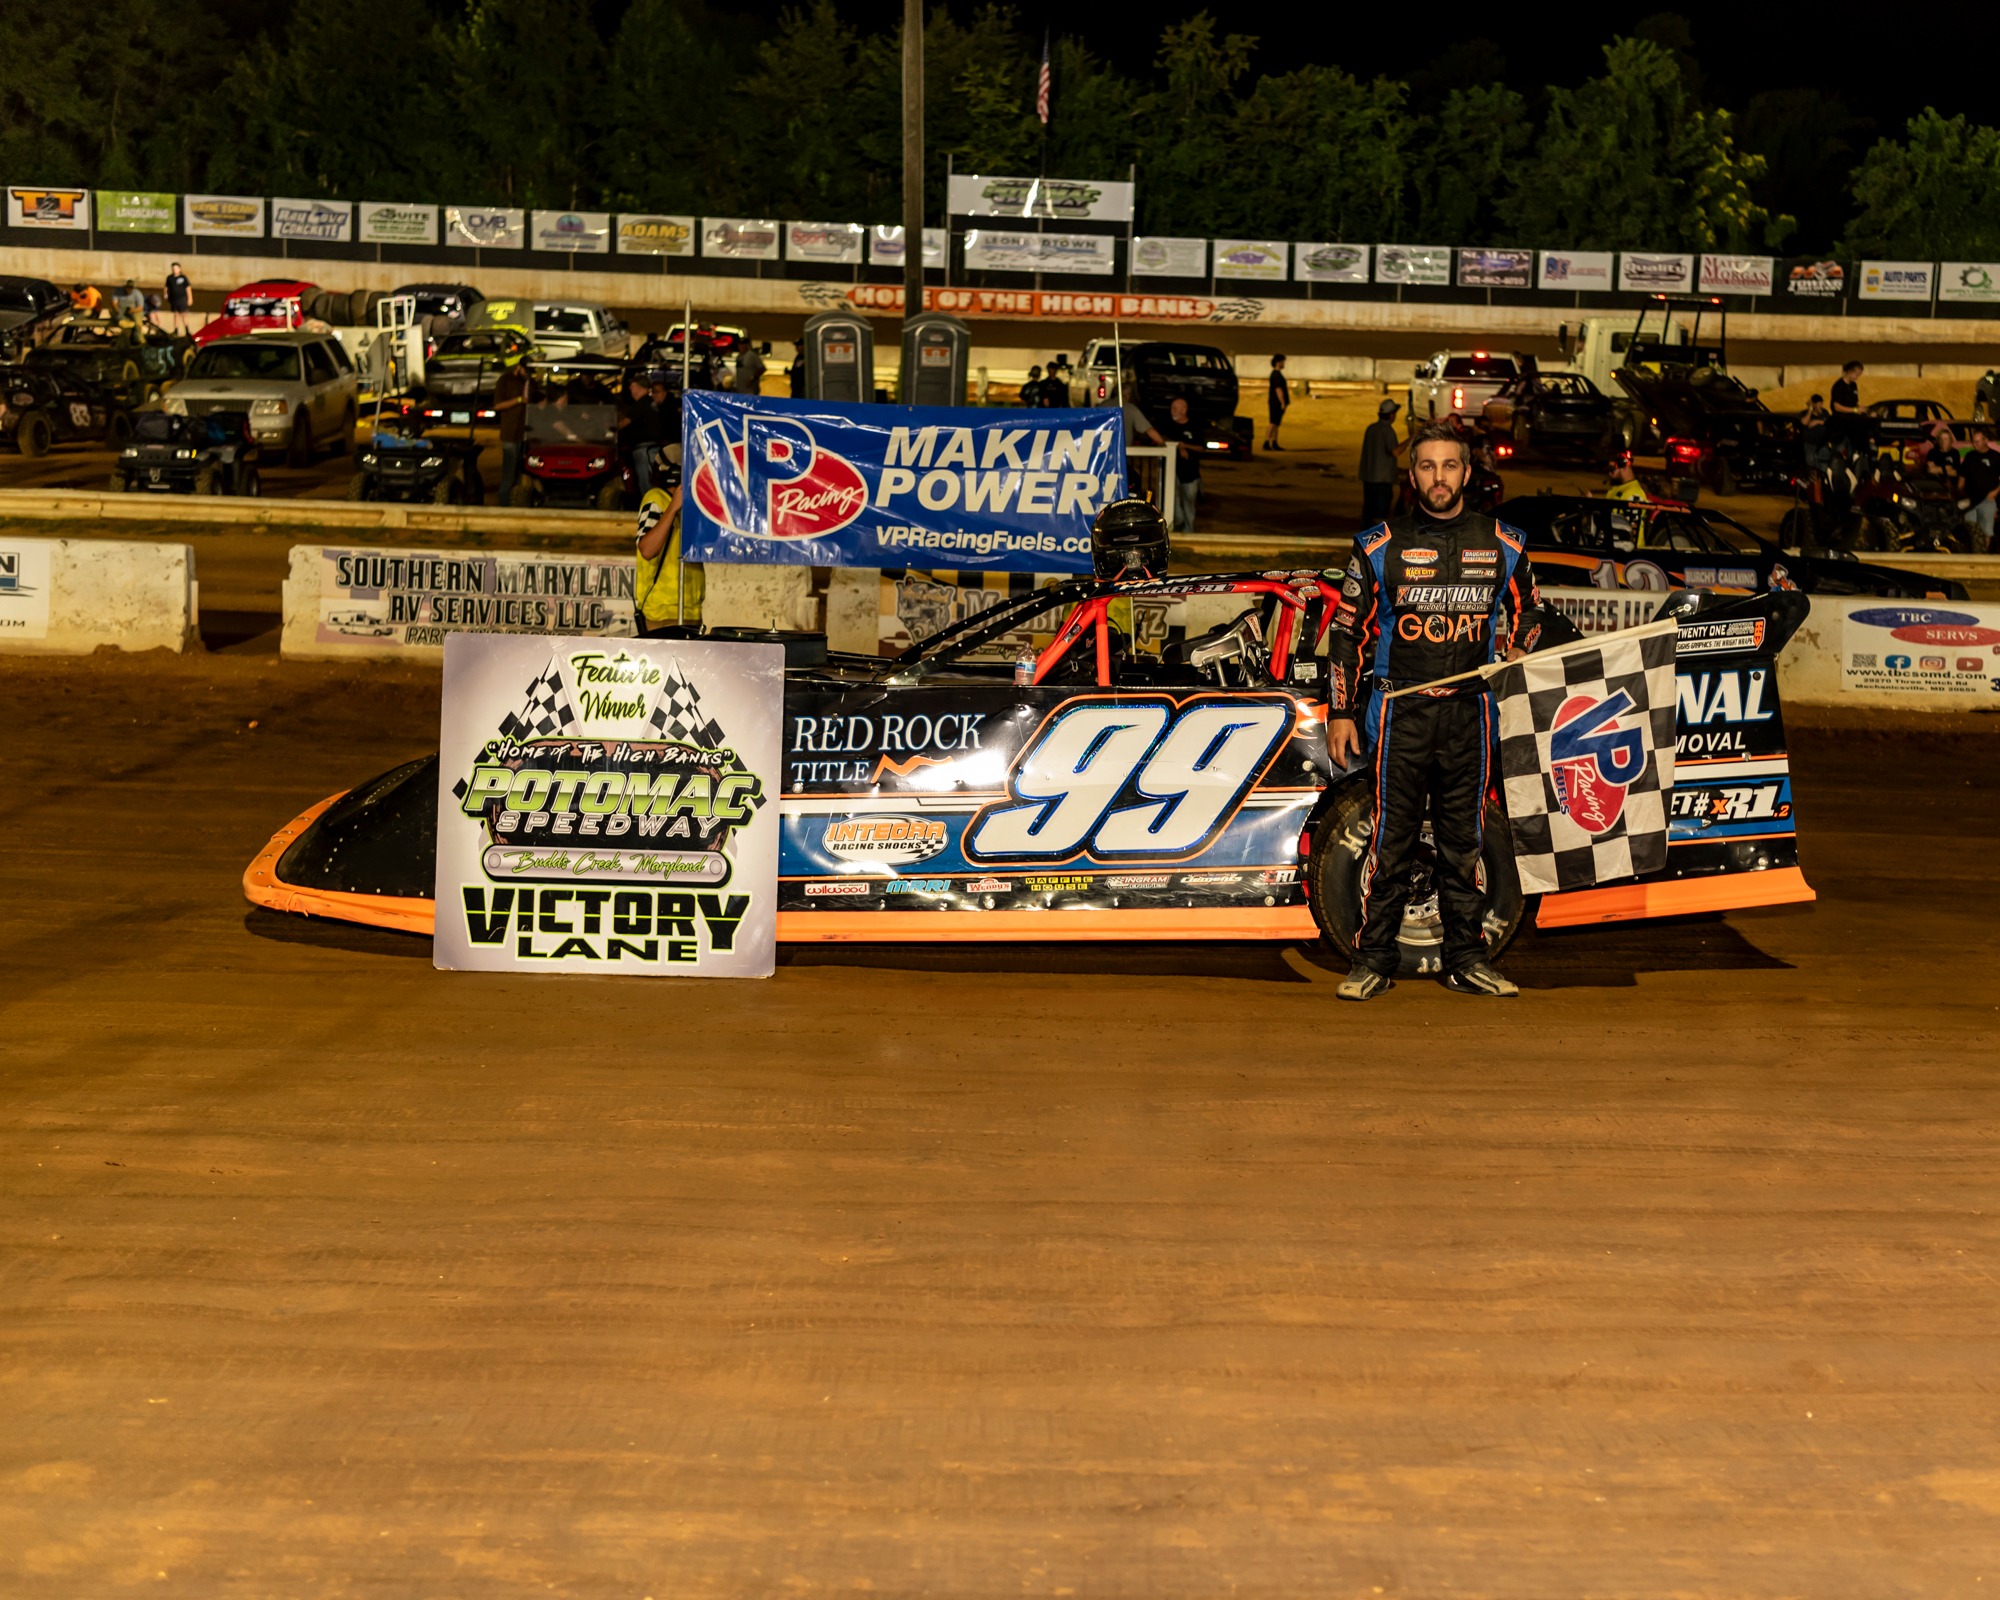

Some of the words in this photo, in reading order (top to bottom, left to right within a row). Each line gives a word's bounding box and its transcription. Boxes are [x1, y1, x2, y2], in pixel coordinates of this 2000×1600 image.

[620, 223, 689, 239] ADAMS
[984, 236, 1096, 248] LEONDTOWN
[1704, 266, 1770, 281] MORGAN
[938, 291, 973, 310] OF
[978, 292, 1032, 313] THE
[1042, 294, 1114, 315] HIGH
[1121, 298, 1212, 317] BANKS
[883, 426, 1113, 471] MAKIN'
[777, 484, 864, 525] Racing
[874, 469, 1120, 515] POWER!
[336, 555, 487, 594] SOUTHERN
[1718, 570, 1756, 586] CAULKING
[387, 593, 423, 624] RV
[430, 596, 549, 629] SERVICES
[553, 600, 606, 630] LLC
[1897, 612, 1932, 623] TBC
[1398, 613, 1489, 642] GOAT
[1678, 625, 1708, 639] TWENTY
[1709, 624, 1727, 637] ONE
[1926, 630, 1978, 641] SERVS
[570, 652, 660, 687] Feature
[1846, 668, 1987, 680] www.tbcsomd.com
[580, 692, 647, 722] Winner
[791, 715, 873, 752] RED
[879, 714, 985, 751] ROCK
[1551, 687, 1647, 787] VP
[791, 761, 870, 783] TITLE
[972, 703, 1288, 856] 99
[464, 767, 755, 818] POTOMAC
[1554, 766, 1570, 816] FUELS
[1567, 761, 1607, 831] Racing
[496, 812, 720, 838] SPEEDWAY
[827, 822, 945, 842] INTEGRA
[833, 843, 873, 851] RACING
[876, 842, 922, 850] SHOCKS
[503, 851, 571, 873] Budds
[573, 853, 624, 875] Creek,
[633, 854, 708, 879] Maryland
[806, 884, 867, 894] wilwood
[1025, 876, 1093, 884] WAFFLE
[1031, 883, 1088, 891] HOUSE
[1124, 876, 1168, 884] INGRAM
[463, 887, 750, 950] VICTORY
[517, 937, 698, 962] LANE
